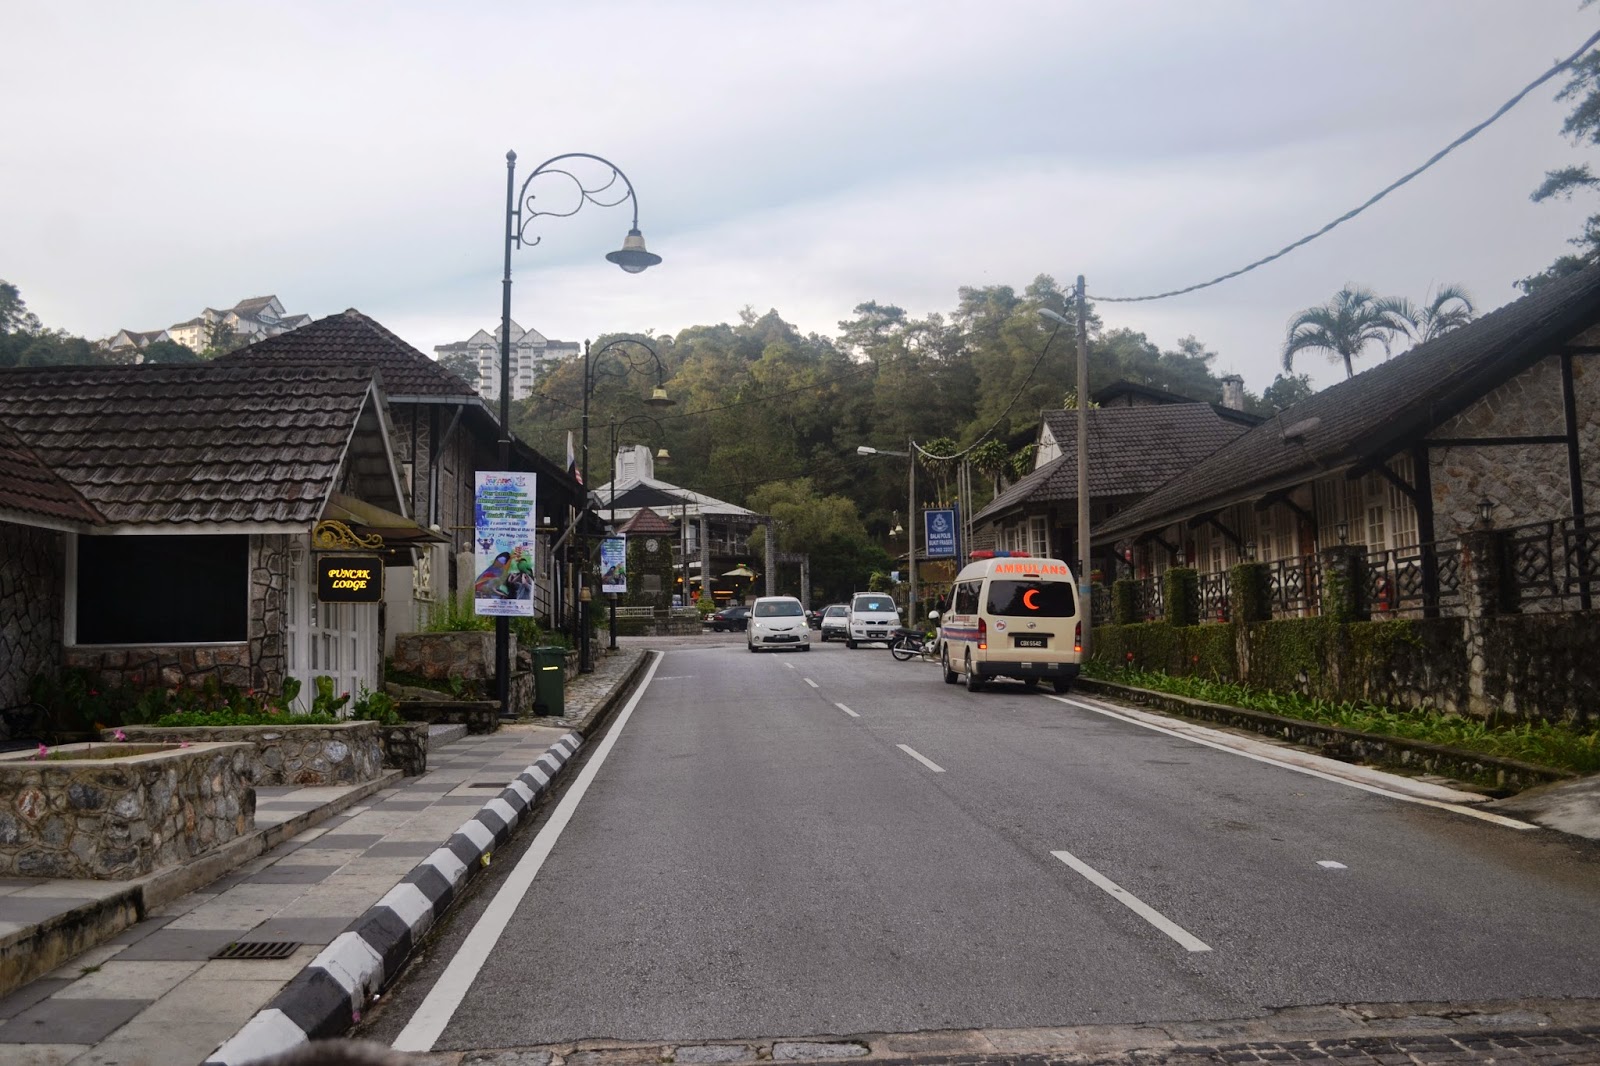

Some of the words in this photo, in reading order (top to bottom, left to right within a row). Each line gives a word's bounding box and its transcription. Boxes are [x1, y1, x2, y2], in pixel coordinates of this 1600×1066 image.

[328, 568, 371, 579] PUNCAK
[995, 563, 1067, 575] AMBULANS
[332, 579, 367, 591] LODGE
